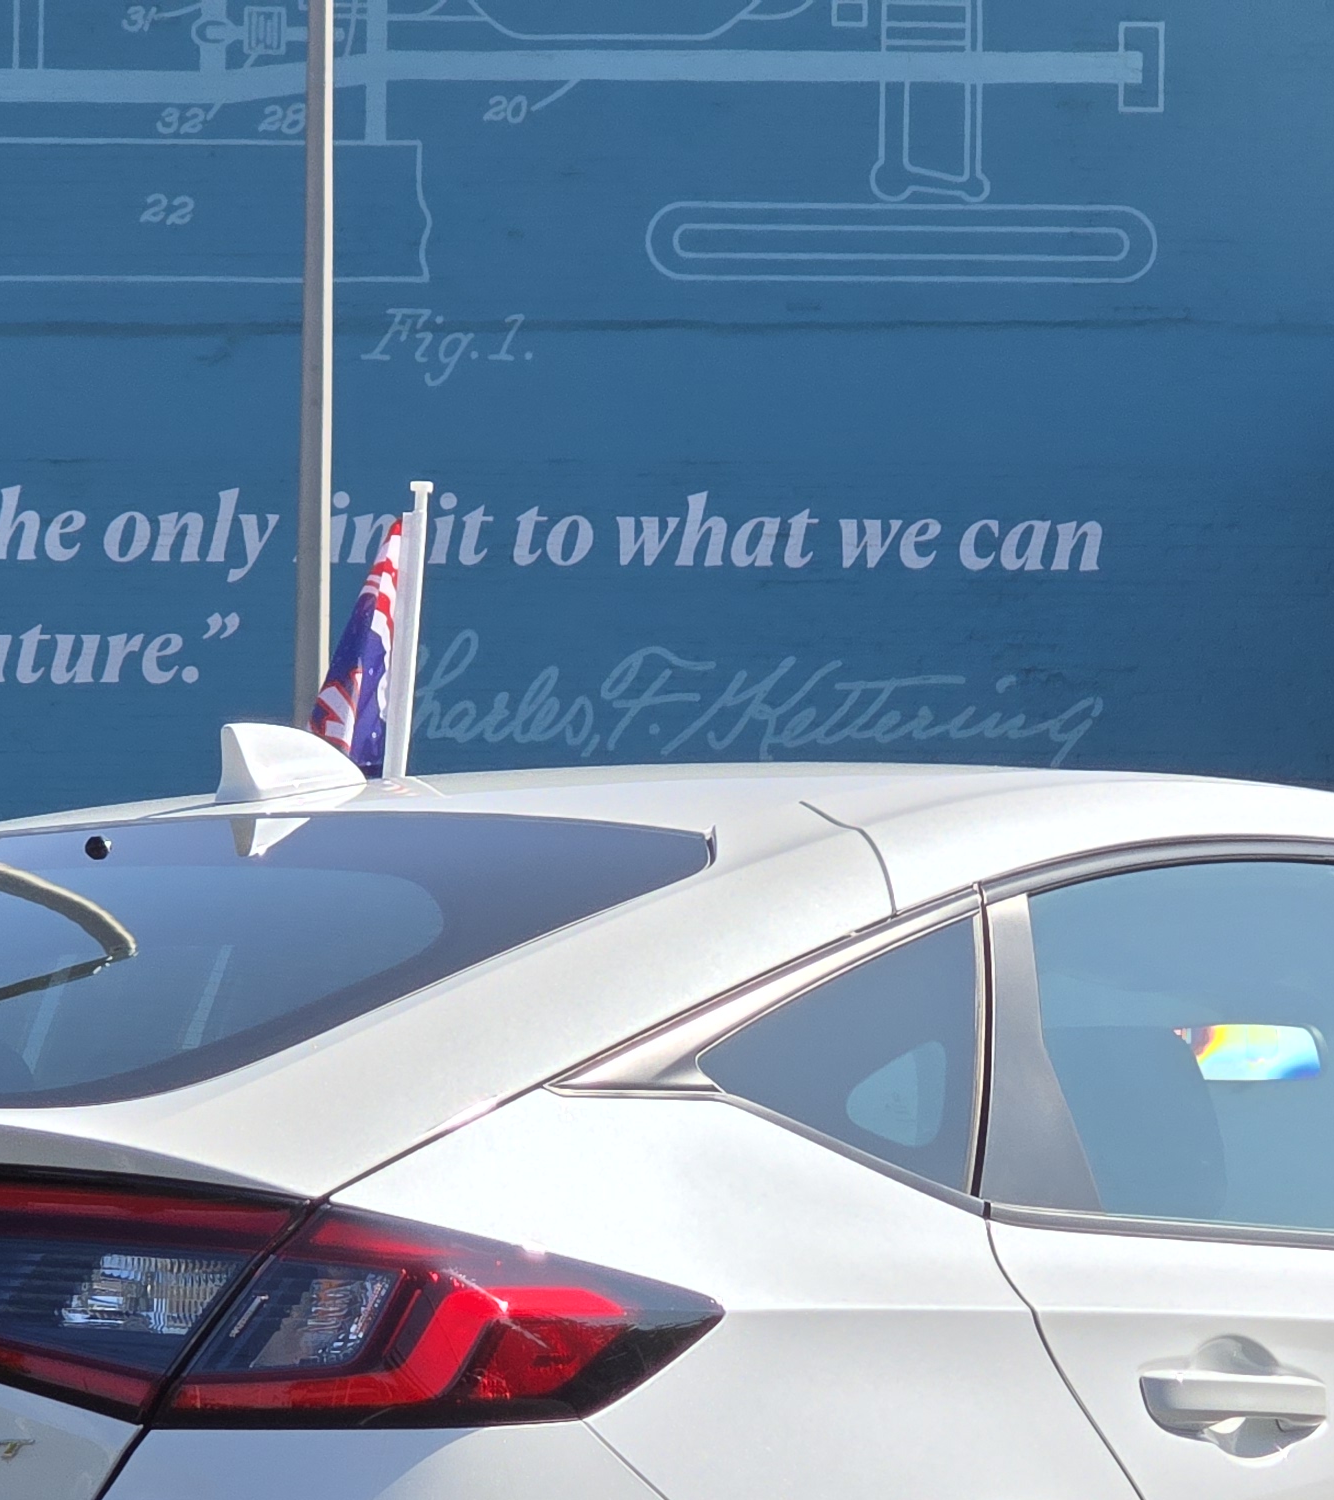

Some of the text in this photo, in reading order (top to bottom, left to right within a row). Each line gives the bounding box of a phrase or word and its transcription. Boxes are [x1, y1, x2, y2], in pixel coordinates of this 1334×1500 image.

[257, 101, 306, 135] 28
[482, 93, 529, 125] 20
[139, 192, 194, 227] 22
[103, 486, 280, 583] only
[512, 504, 595, 568] to
[617, 489, 819, 571] what
[838, 515, 939, 571] we
[957, 518, 1104, 573] can
